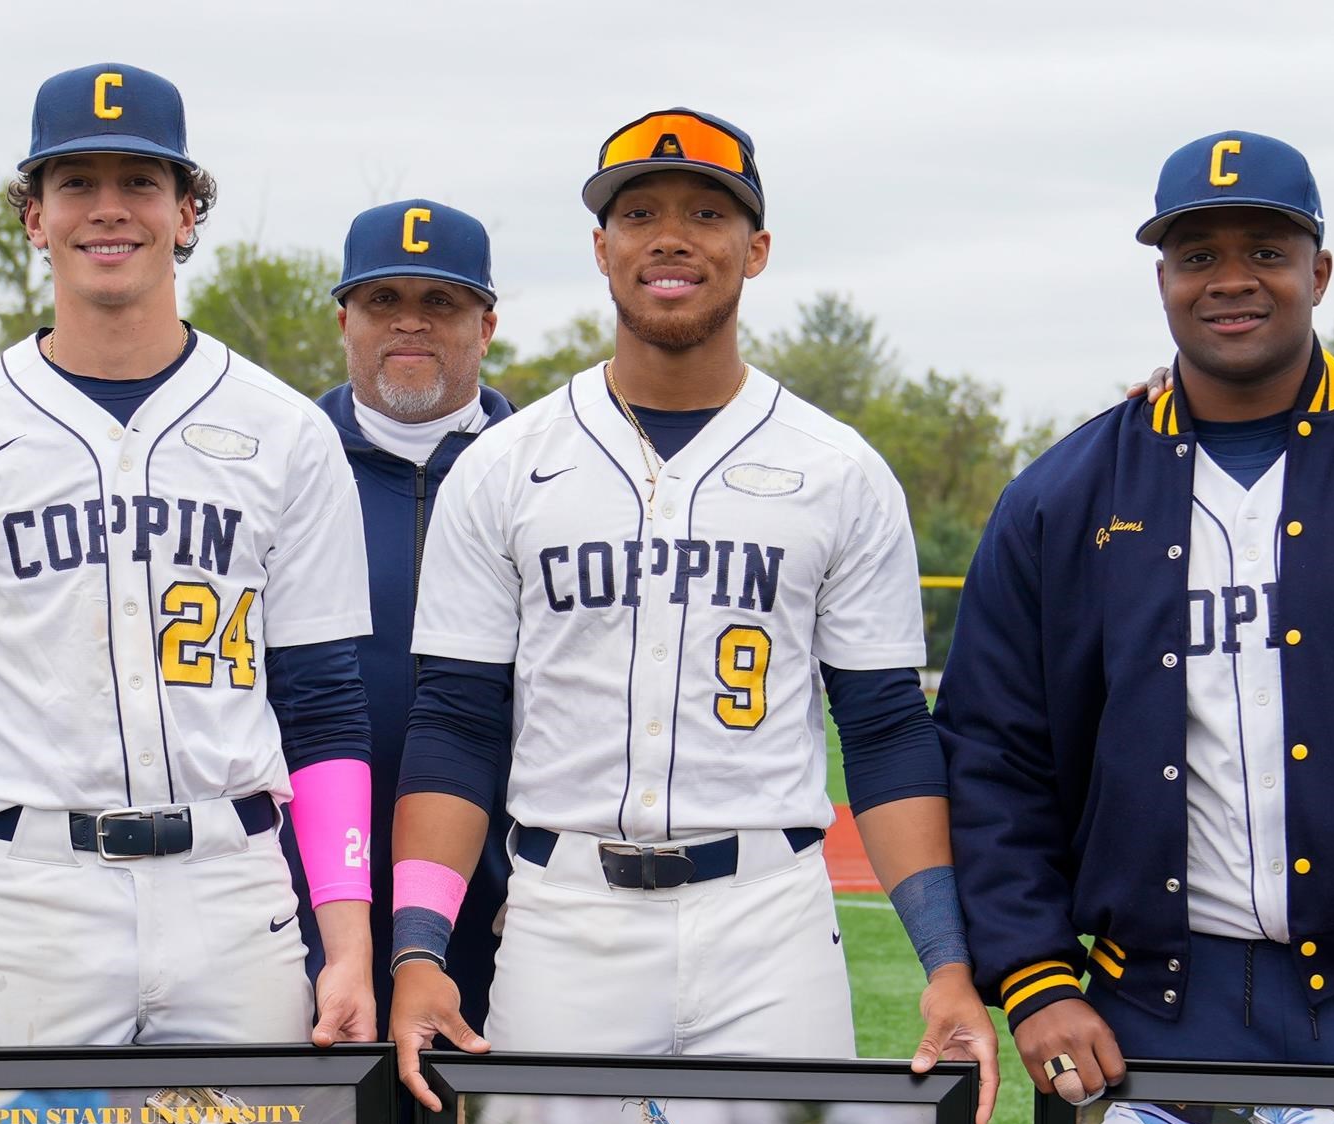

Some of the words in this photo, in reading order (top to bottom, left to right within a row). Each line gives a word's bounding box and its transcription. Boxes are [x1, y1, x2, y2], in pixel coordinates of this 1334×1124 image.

[93, 73, 124, 119] C
[1209, 140, 1241, 187] C
[402, 208, 431, 253] C
[2, 495, 243, 579] COPPIN
[539, 537, 785, 613] COPPIN
[159, 581, 257, 689] 24
[713, 624, 773, 731] 9
